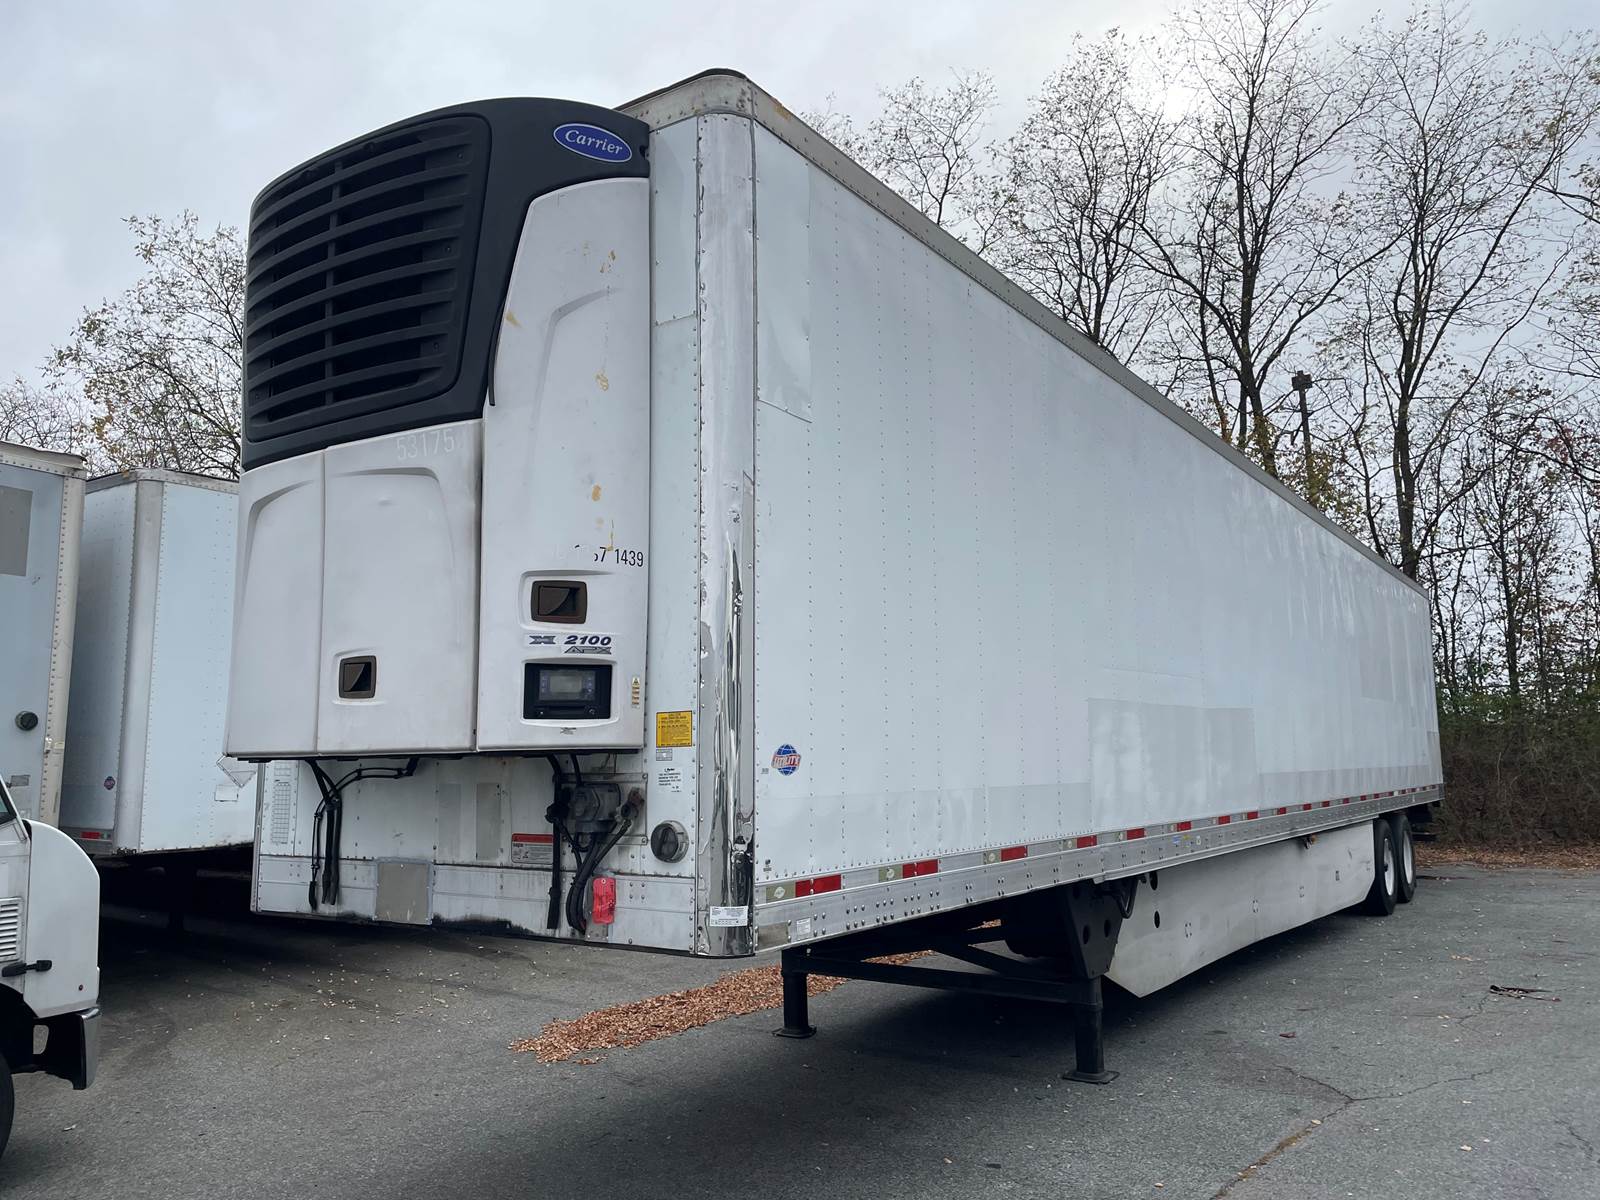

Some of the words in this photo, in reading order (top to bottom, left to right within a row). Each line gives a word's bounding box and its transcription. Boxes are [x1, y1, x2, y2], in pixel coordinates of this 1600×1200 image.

[565, 129, 623, 155] Carrier
[396, 428, 455, 461] 53175
[614, 548, 644, 567] 1439
[564, 635, 612, 646] 2100
